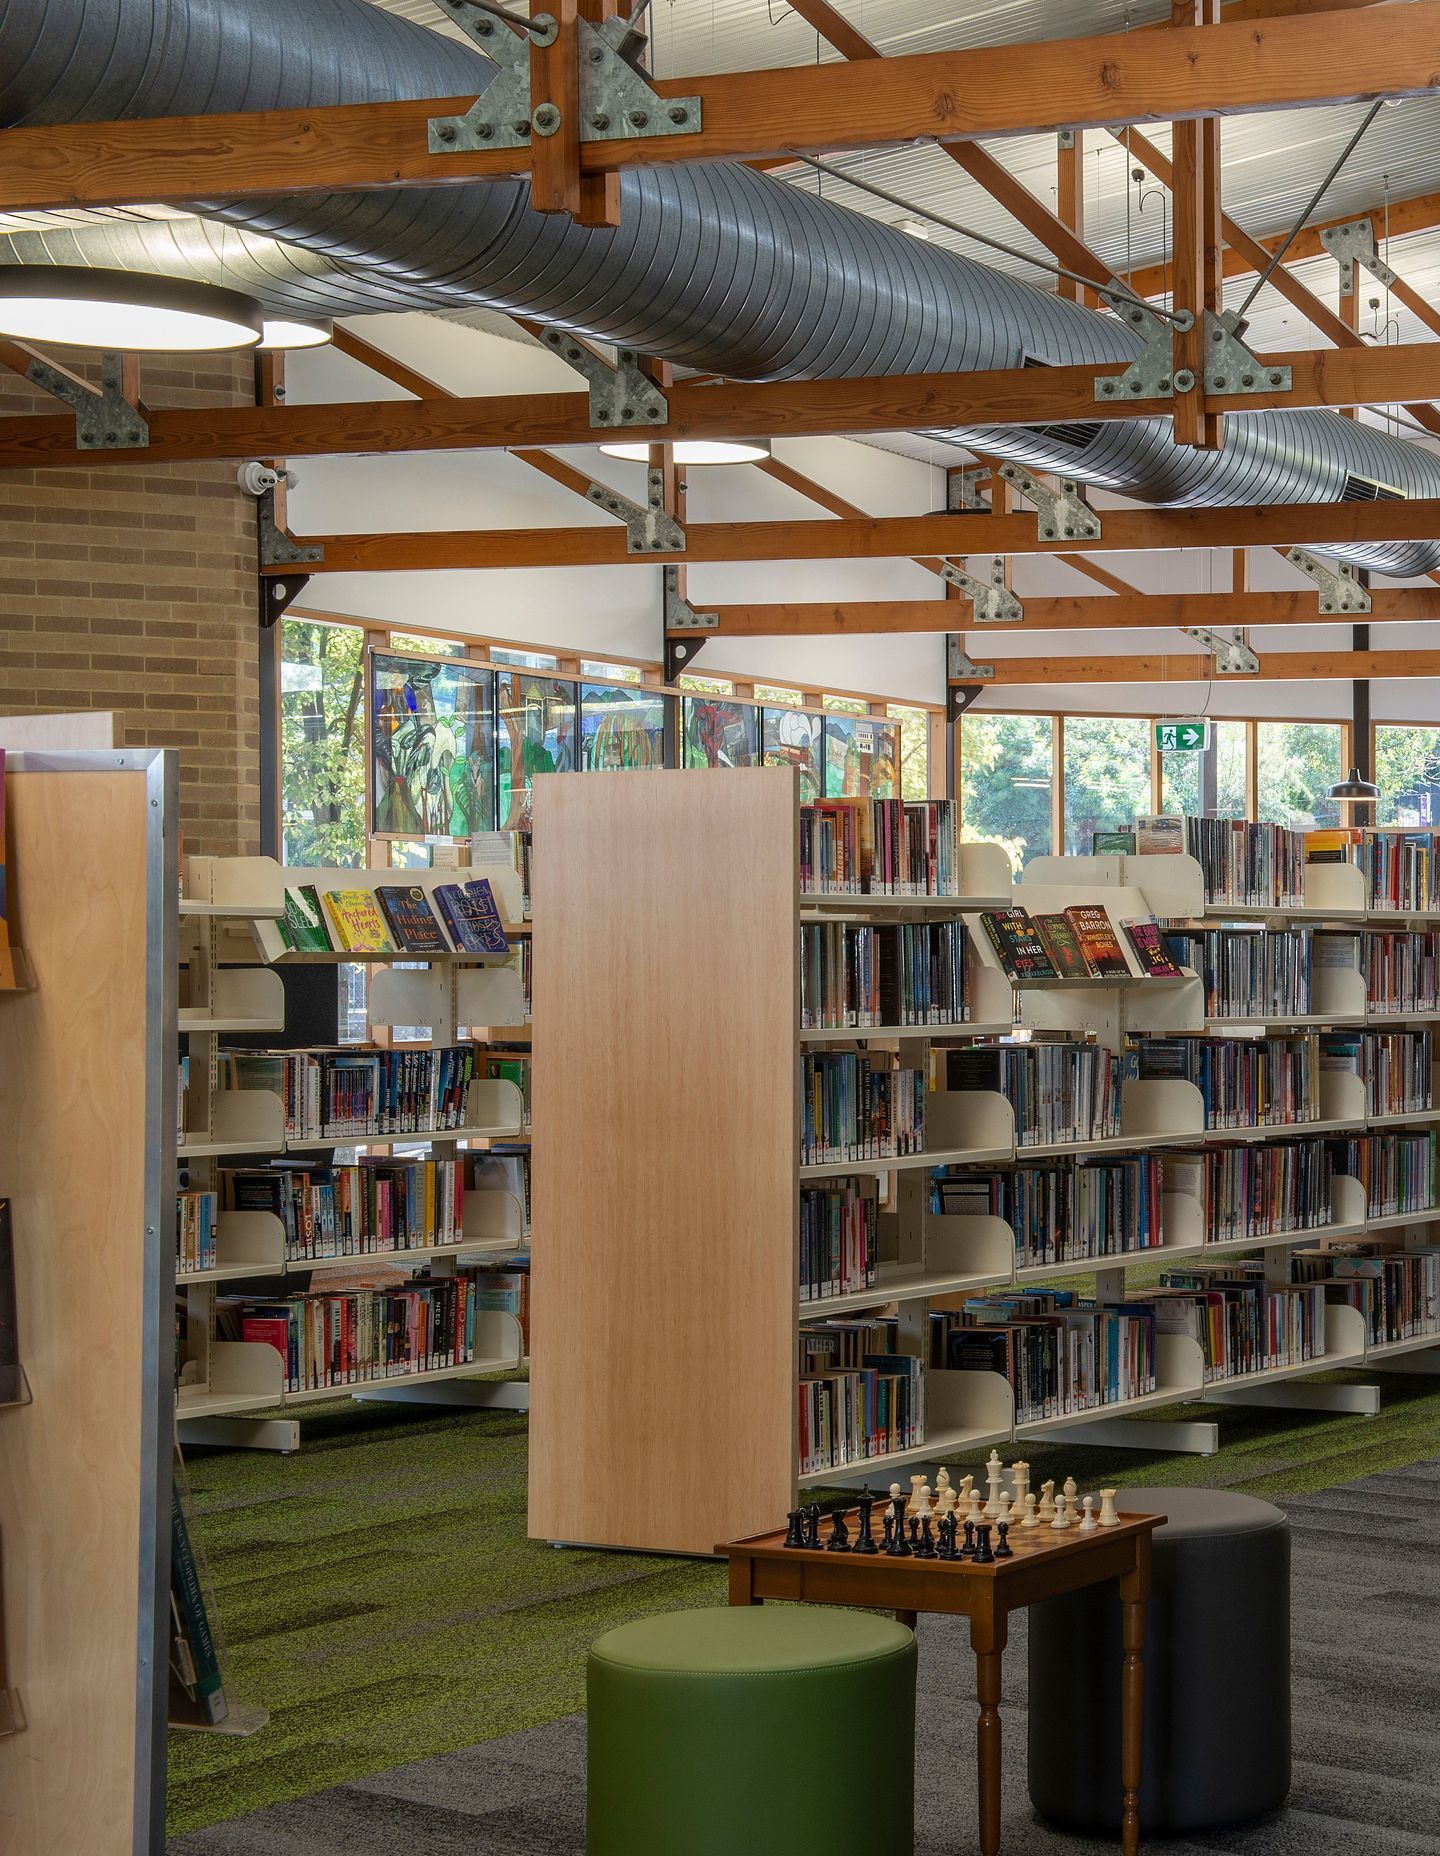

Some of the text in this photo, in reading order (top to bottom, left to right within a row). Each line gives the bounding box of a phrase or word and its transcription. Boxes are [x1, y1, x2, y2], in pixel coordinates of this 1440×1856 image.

[400, 899, 417, 910] The
[341, 906, 377, 921] Anchored
[1007, 909, 1025, 918] GIRL
[1080, 910, 1101, 919] GREG
[288, 914, 314, 929] SLEE
[352, 919, 381, 931] Hearts
[396, 914, 433, 925] Hiding
[1002, 921, 1024, 931] WITH
[1080, 920, 1112, 931] BARRON
[404, 928, 438, 940] Place
[1085, 933, 1116, 941] WHISTLER'S
[1095, 940, 1114, 948] BONES
[1016, 945, 1044, 955] IN HER
[1014, 959, 1034, 968] EYES
[174, 1518, 198, 1606] ENCYCLOPEDIA
[194, 1603, 203, 1617] OF
[198, 1621, 211, 1658] GAMES
